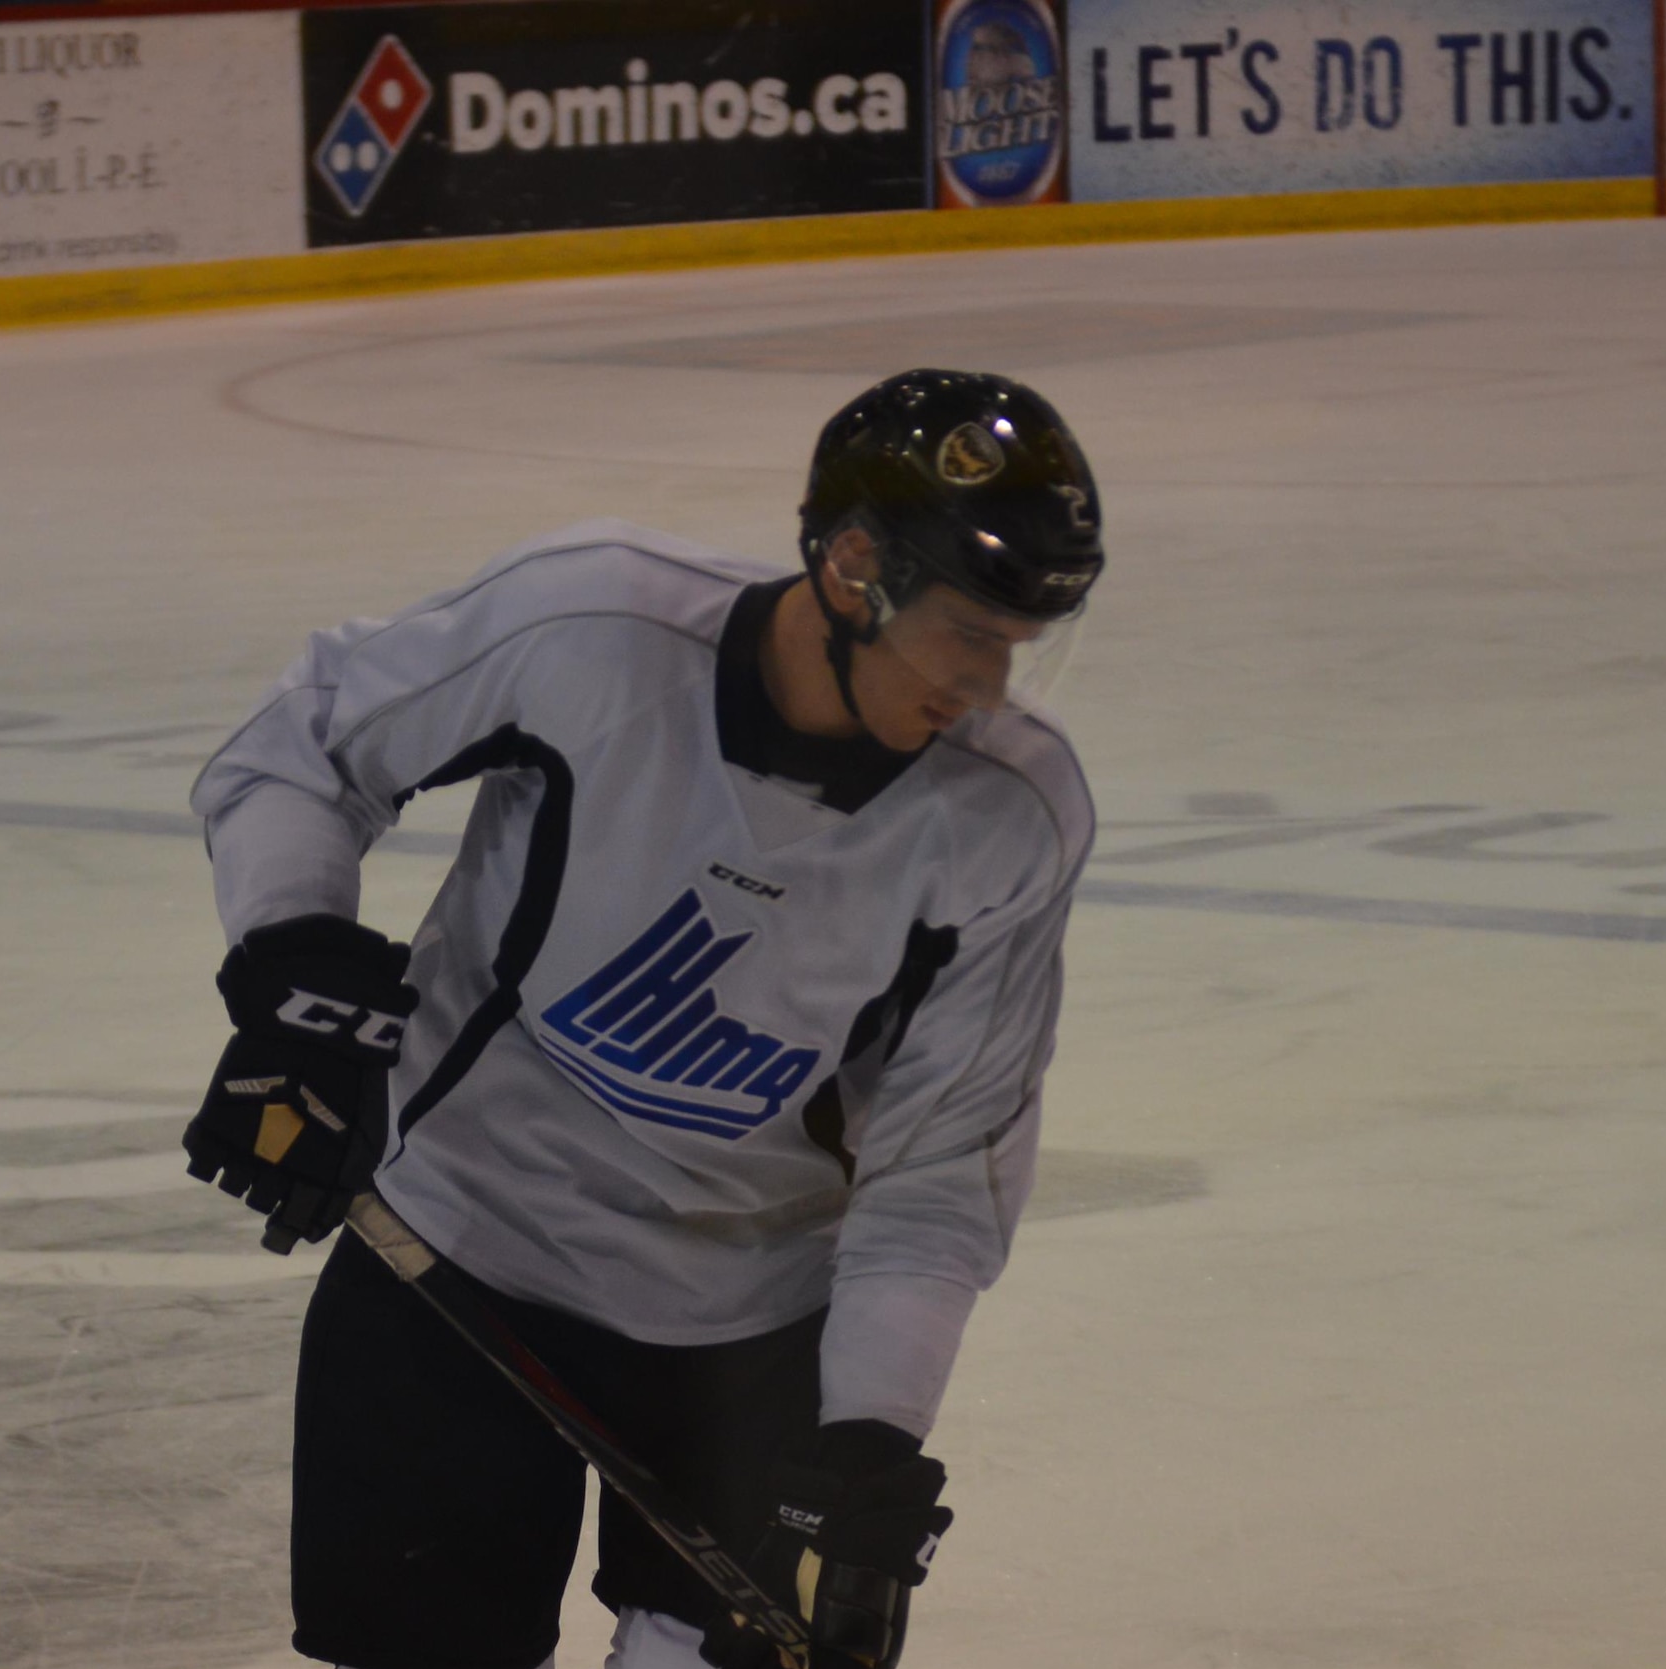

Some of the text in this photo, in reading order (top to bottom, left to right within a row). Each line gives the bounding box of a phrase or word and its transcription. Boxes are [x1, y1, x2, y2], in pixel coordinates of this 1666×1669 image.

[16, 32, 142, 79] LIQUOR
[448, 57, 909, 153] Dominos.ca
[1092, 27, 1634, 142] LET'S DO THIS.
[937, 109, 1060, 159] LIGHT
[708, 861, 786, 900] CCM
[275, 986, 409, 1052] CC
[778, 1503, 825, 1526] CCM
